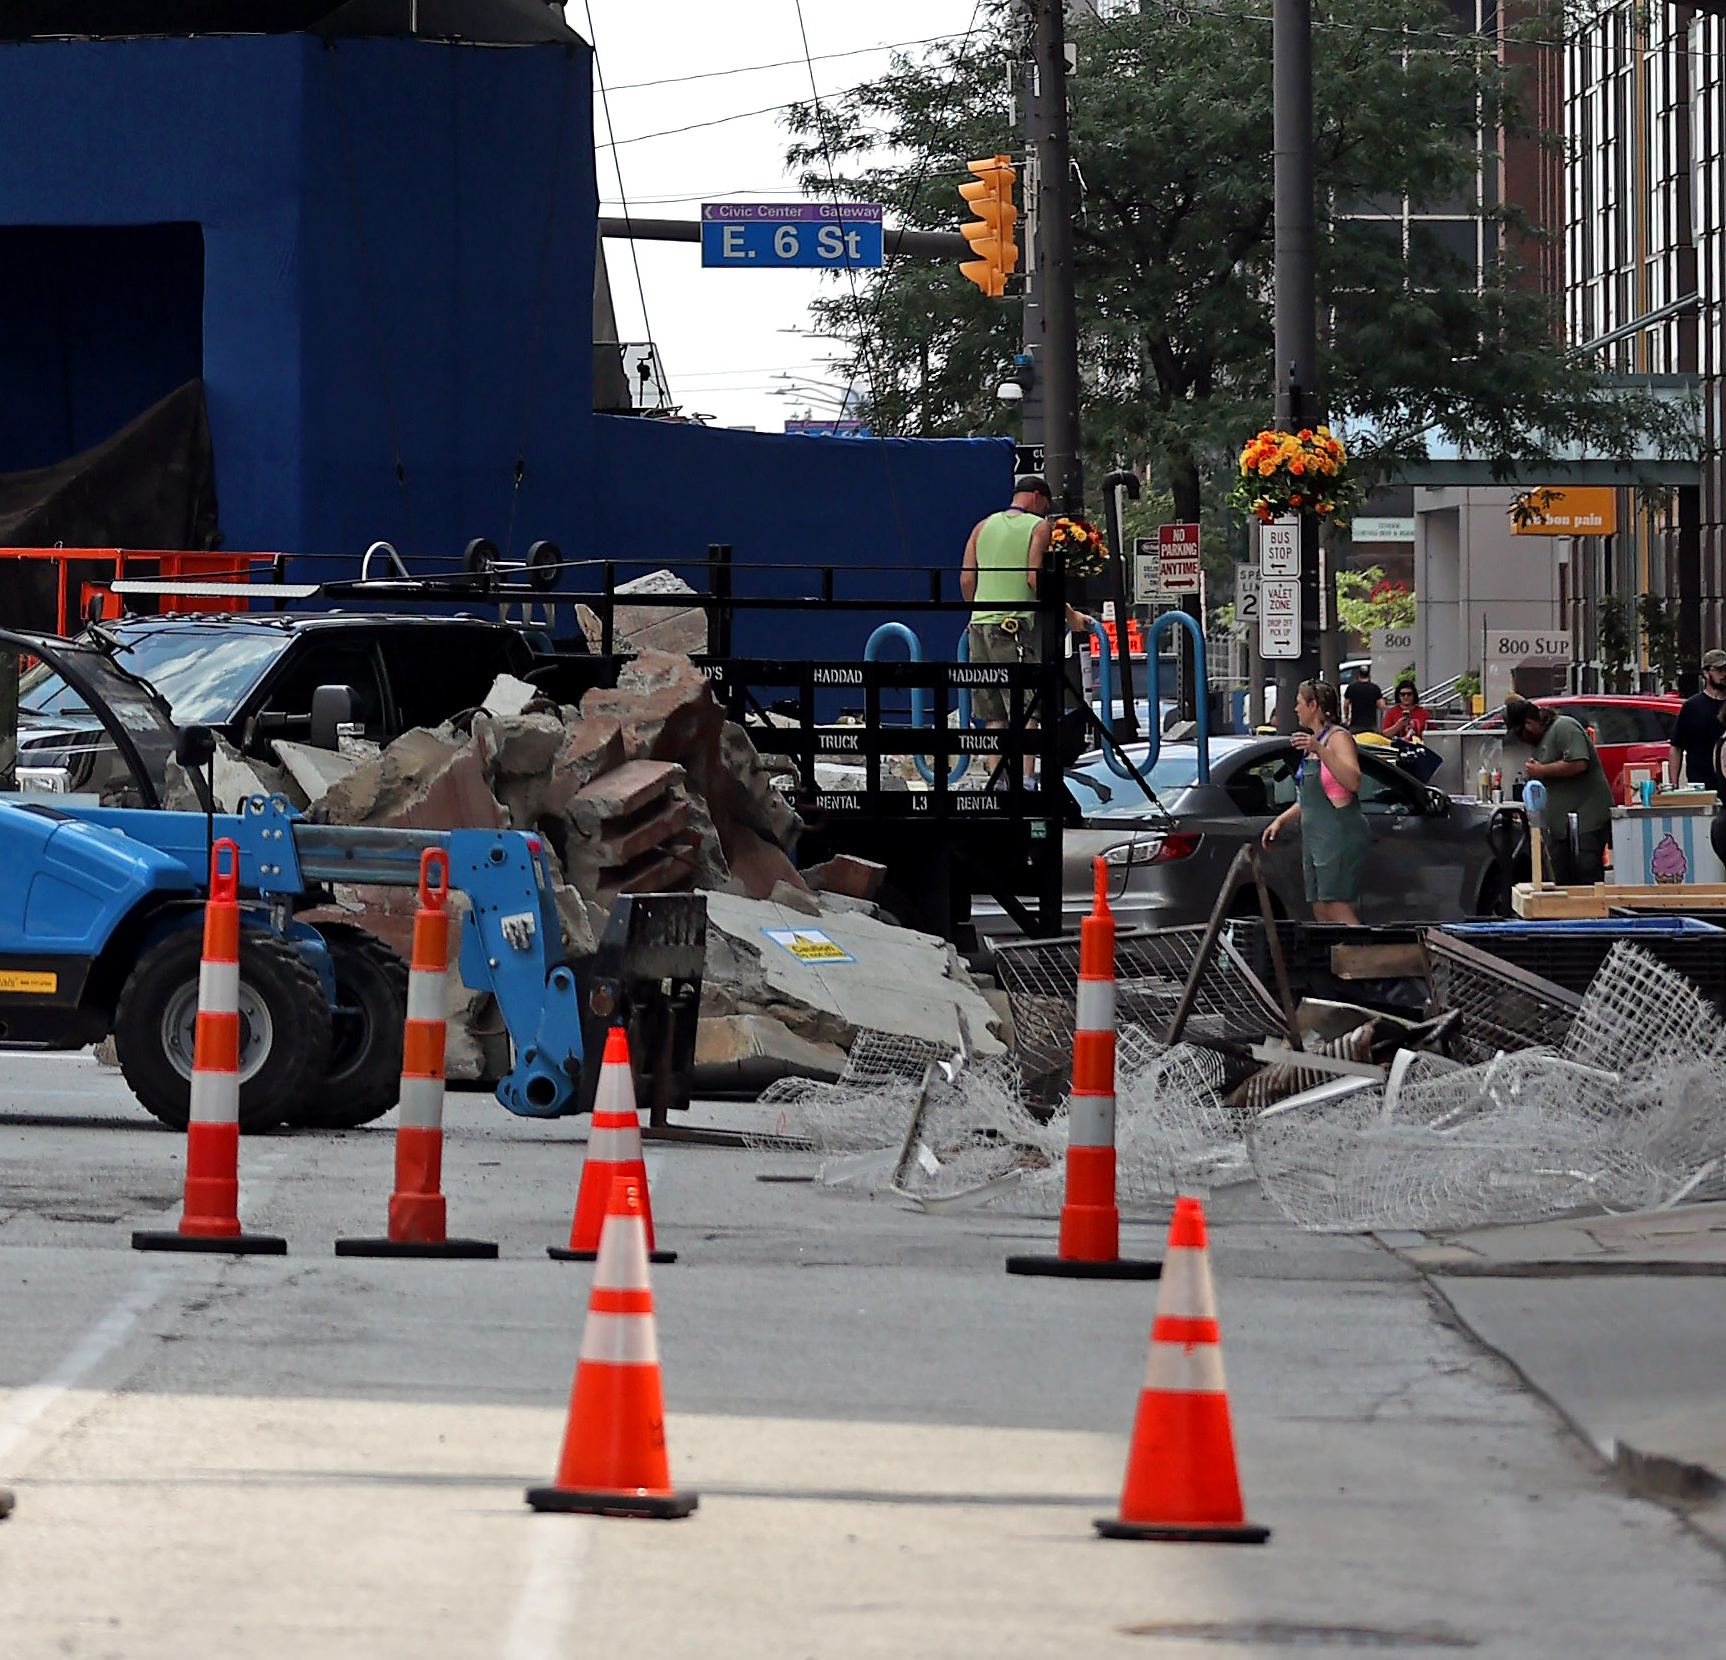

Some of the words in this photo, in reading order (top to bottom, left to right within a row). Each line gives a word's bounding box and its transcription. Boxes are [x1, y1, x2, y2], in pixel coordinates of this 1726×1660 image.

[719, 205, 753, 217] Civic
[757, 205, 803, 217] Center
[819, 205, 879, 219] Gateway
[723, 225, 756, 258] E.
[774, 225, 800, 259] 6
[817, 225, 861, 259] St
[1545, 513, 1570, 525] bon
[1574, 513, 1602, 528] pain
[1173, 528, 1186, 542] NO
[1270, 532, 1290, 544] BUS
[1161, 542, 1197, 558] PARKING
[1268, 547, 1293, 560] STOP
[1160, 561, 1198, 576] ANYTIME
[1268, 588, 1293, 600] VALET
[1242, 594, 1258, 615] 2
[1269, 600, 1292, 610] ZONE
[1267, 619, 1281, 628] DROP
[1282, 619, 1293, 628] OFF
[1385, 634, 1411, 648] 800
[1499, 638, 1529, 654] 800
[813, 669, 863, 684] HADDAD
[948, 668, 1009, 684] HADDAD'S
[818, 735, 859, 750] TRUCK
[958, 735, 999, 750] TRUCK
[816, 796, 861, 810] RENTAL
[912, 796, 928, 811] L3
[956, 796, 1000, 811] RENTAL
